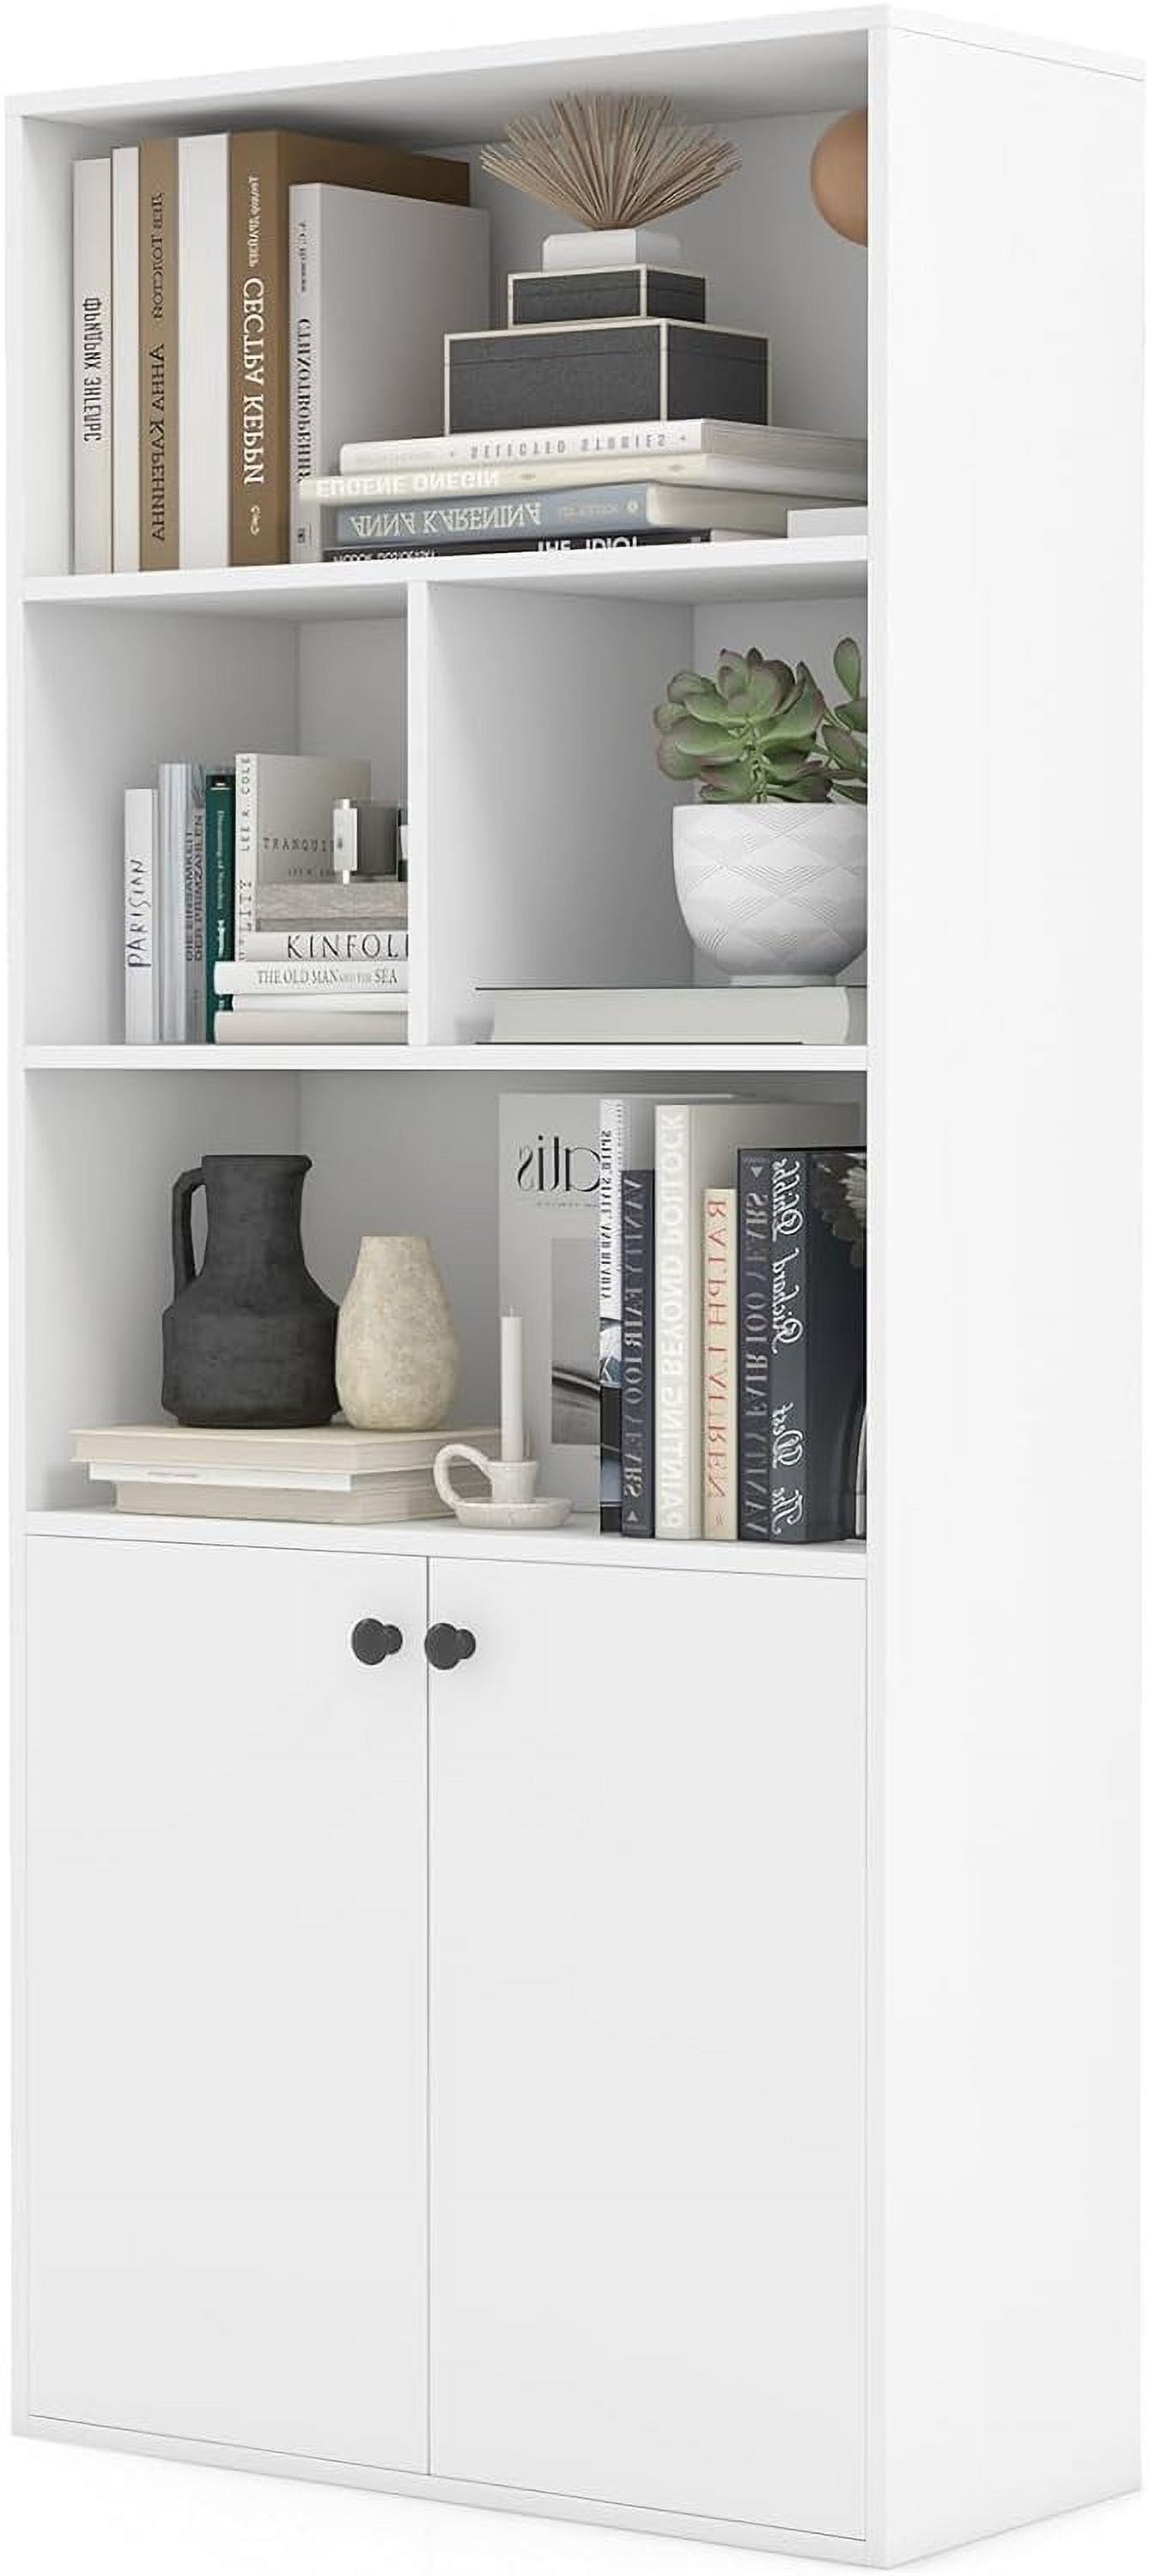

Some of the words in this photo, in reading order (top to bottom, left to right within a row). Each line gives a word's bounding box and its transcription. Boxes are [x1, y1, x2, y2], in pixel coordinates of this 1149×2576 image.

[128, 859, 152, 969] PARISIAN
[258, 969, 280, 984] THE
[283, 969, 308, 984] OLD
[374, 968, 397, 984] SEA
